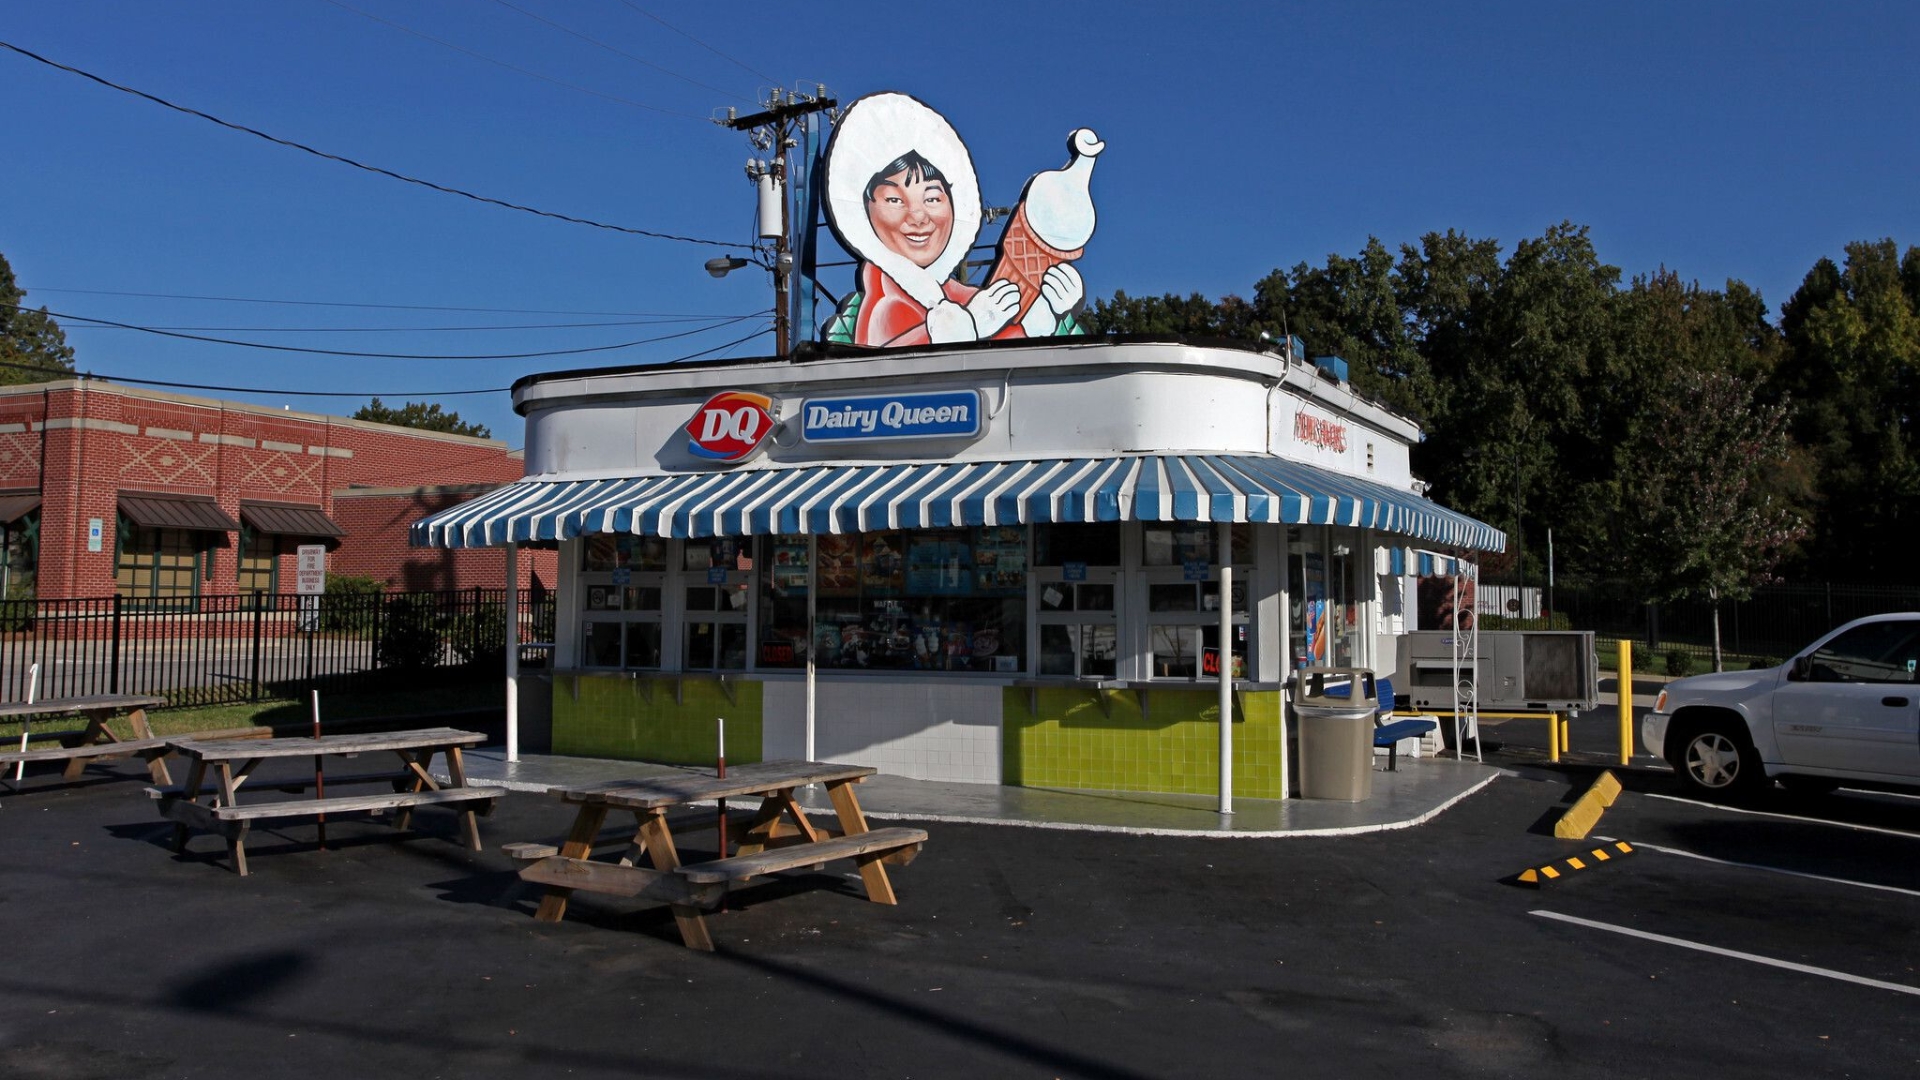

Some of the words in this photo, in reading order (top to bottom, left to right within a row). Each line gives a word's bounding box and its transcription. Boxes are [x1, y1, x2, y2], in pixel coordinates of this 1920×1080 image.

[699, 406, 760, 445] DQ
[806, 405, 878, 433] Dairy
[881, 401, 968, 429] Queen
[763, 645, 793, 662] CLOSED
